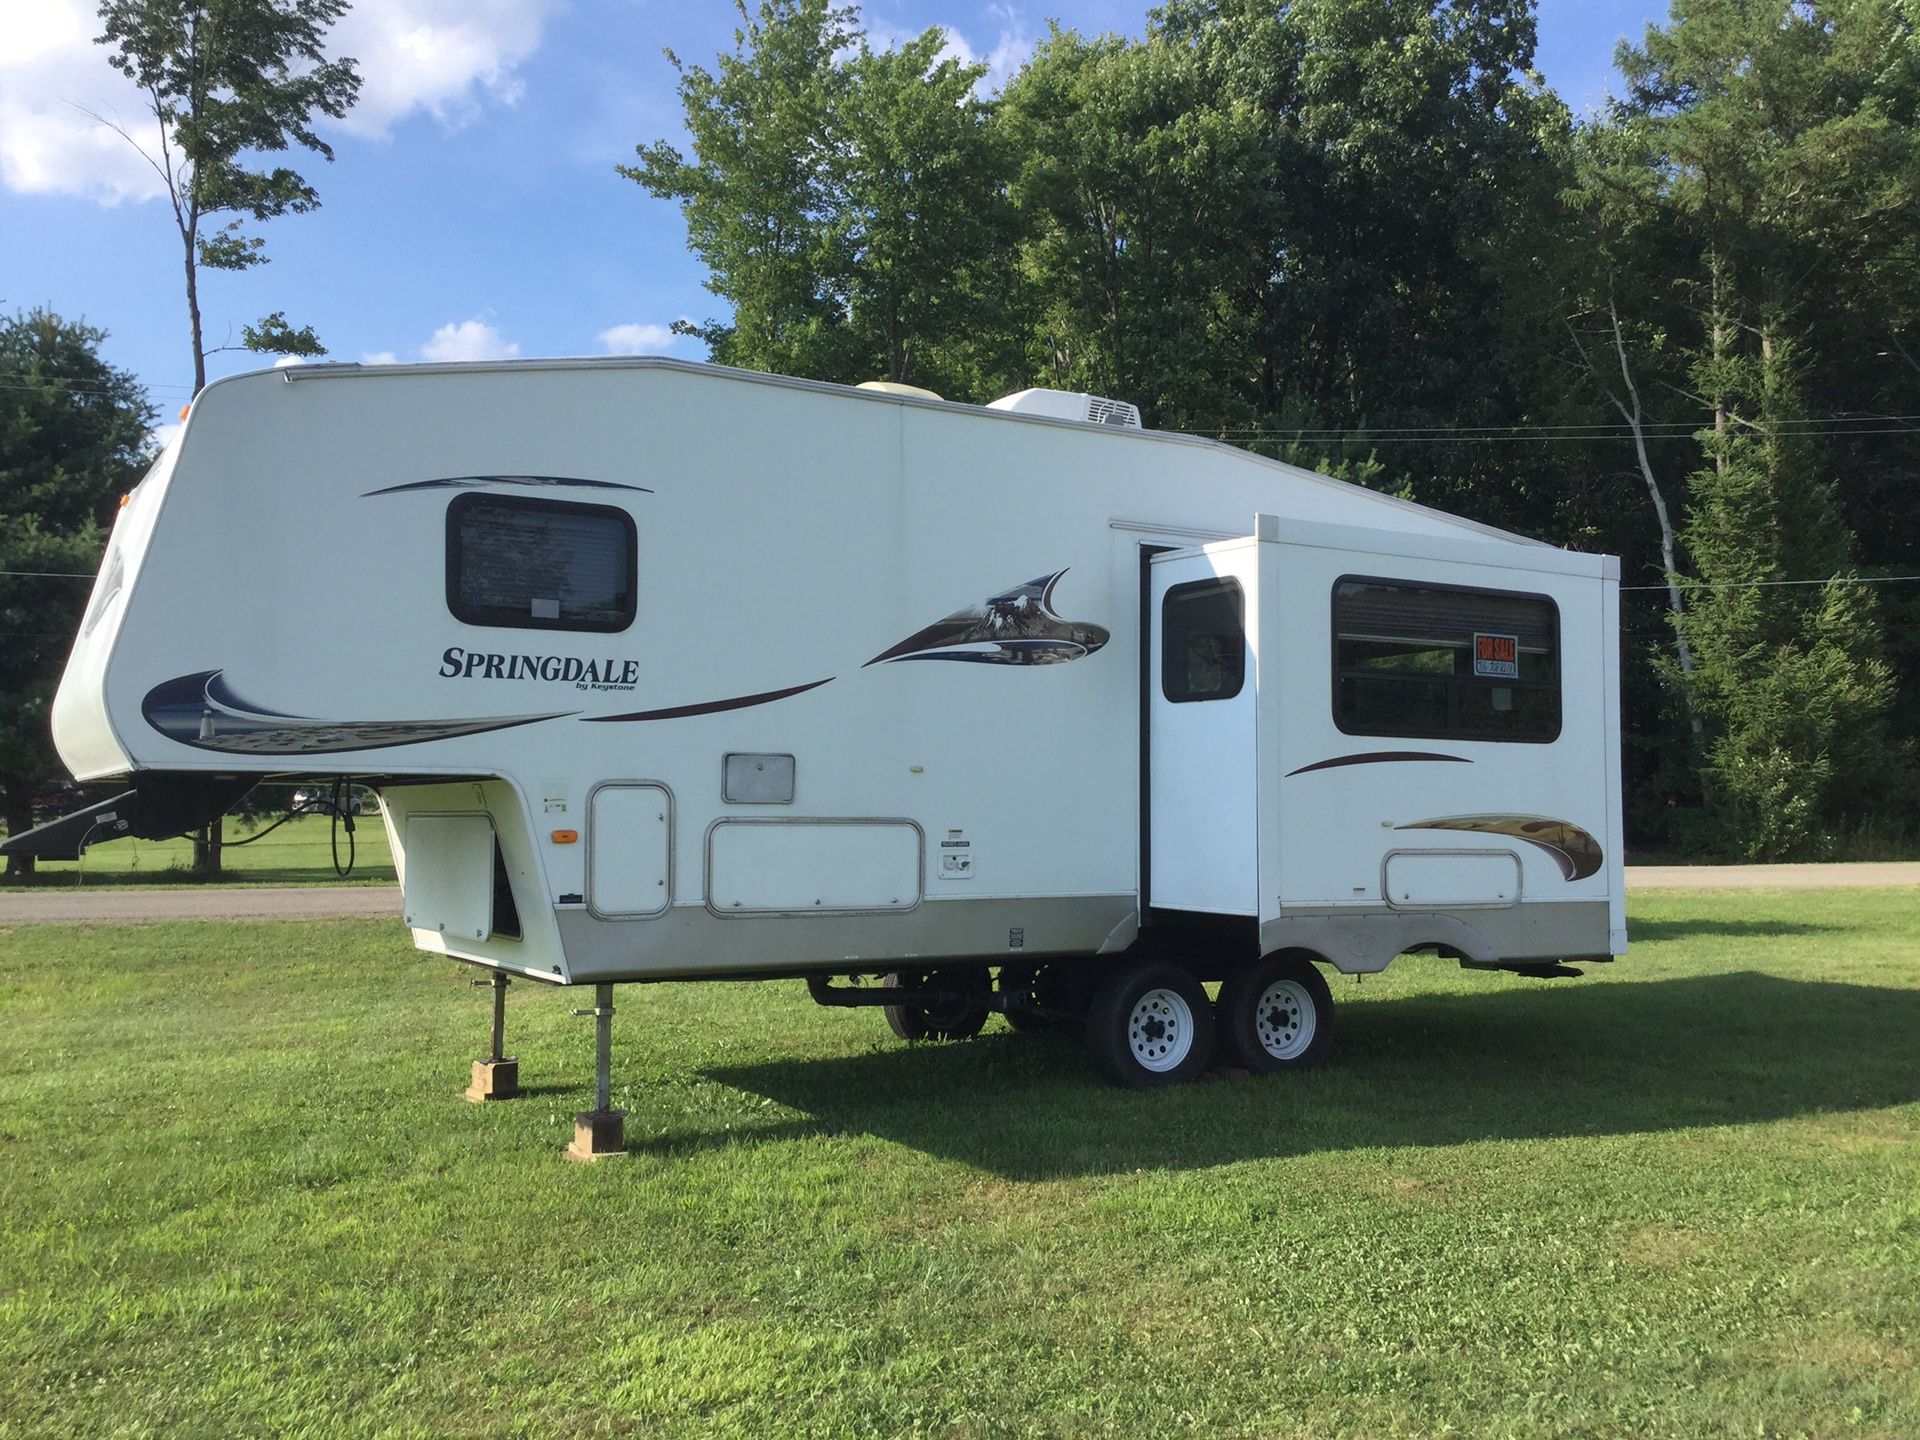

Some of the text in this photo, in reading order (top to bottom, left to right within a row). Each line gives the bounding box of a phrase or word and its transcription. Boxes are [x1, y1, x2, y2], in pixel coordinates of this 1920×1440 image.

[1477, 637, 1515, 662] FOR SALE
[439, 647, 640, 684] SPRINGDALE
[576, 682, 635, 692] by Keystone
